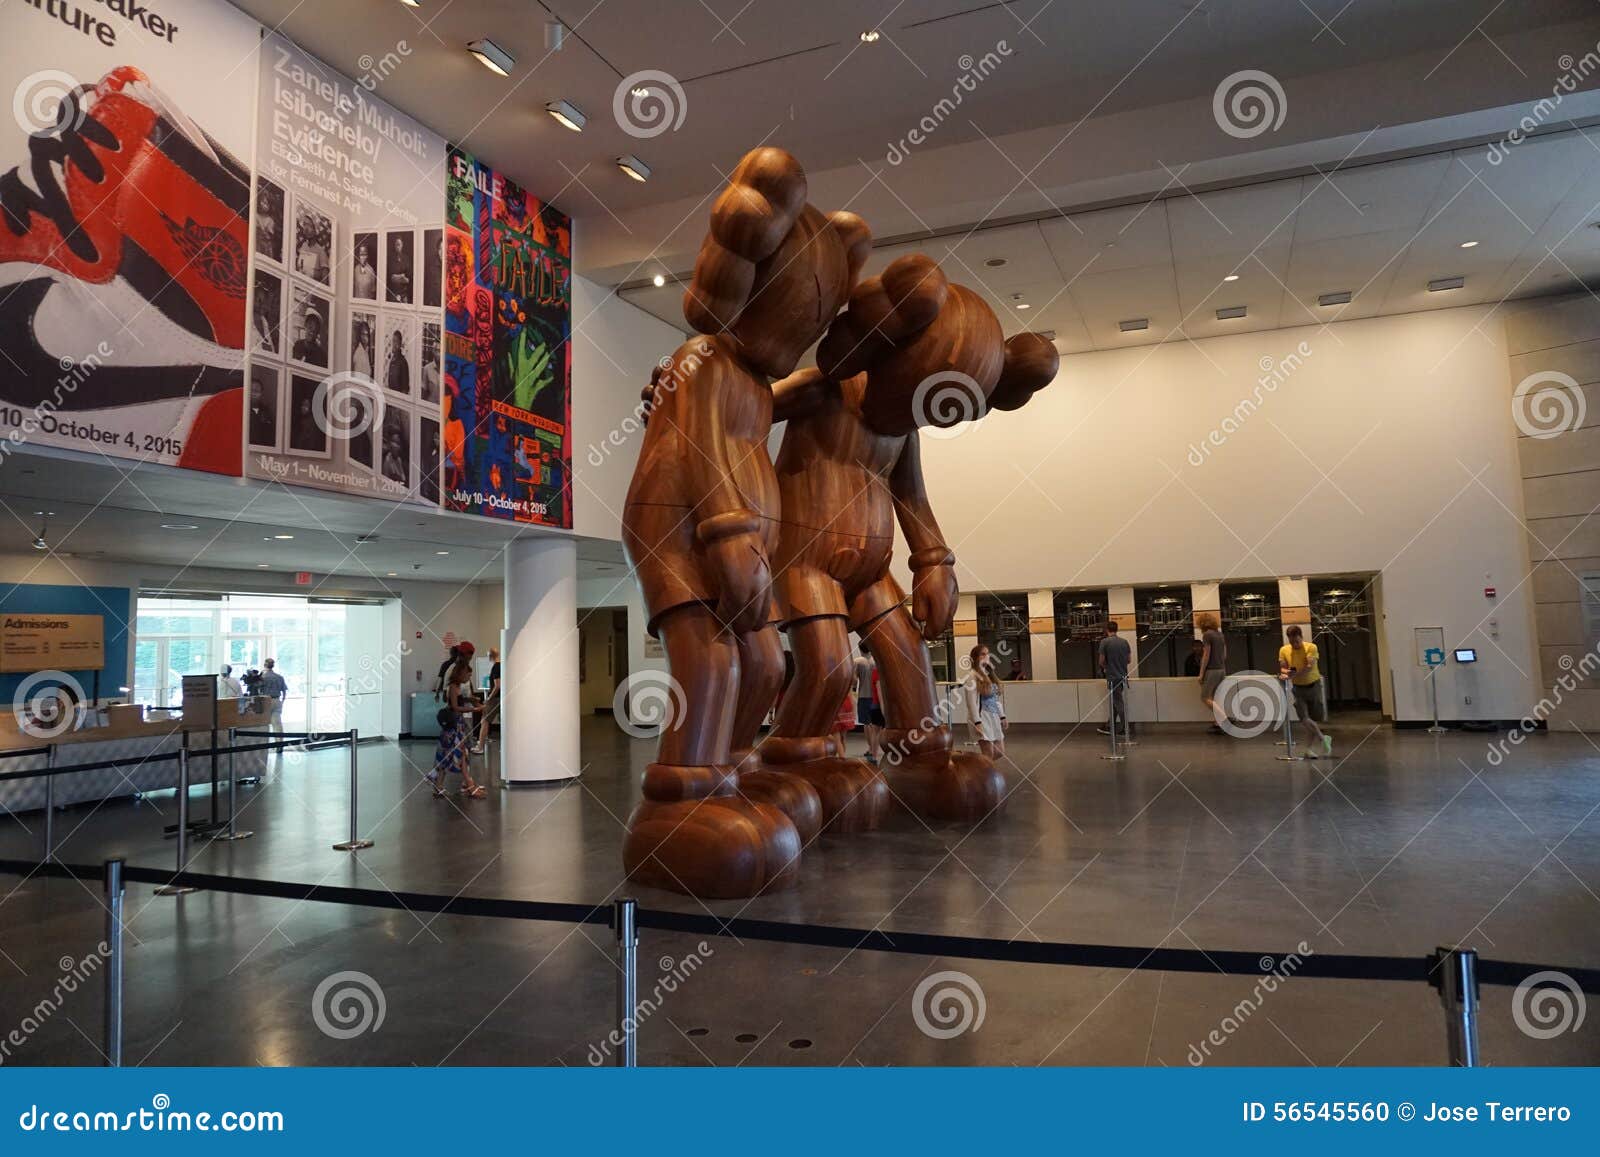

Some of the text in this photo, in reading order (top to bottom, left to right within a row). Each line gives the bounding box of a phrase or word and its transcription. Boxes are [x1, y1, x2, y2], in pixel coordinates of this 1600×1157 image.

[24, 0, 117, 47] ture
[97, 0, 178, 43] aker
[274, 46, 428, 158] Zanele Muholi:
[273, 110, 374, 185] Evidence
[454, 156, 503, 202] FAILE
[124, 431, 140, 453] 4,
[144, 434, 182, 456] 2015
[259, 455, 290, 476] May
[453, 489, 472, 505] July
[530, 502, 547, 515] 2015
[4, 618, 69, 629] Admissions
